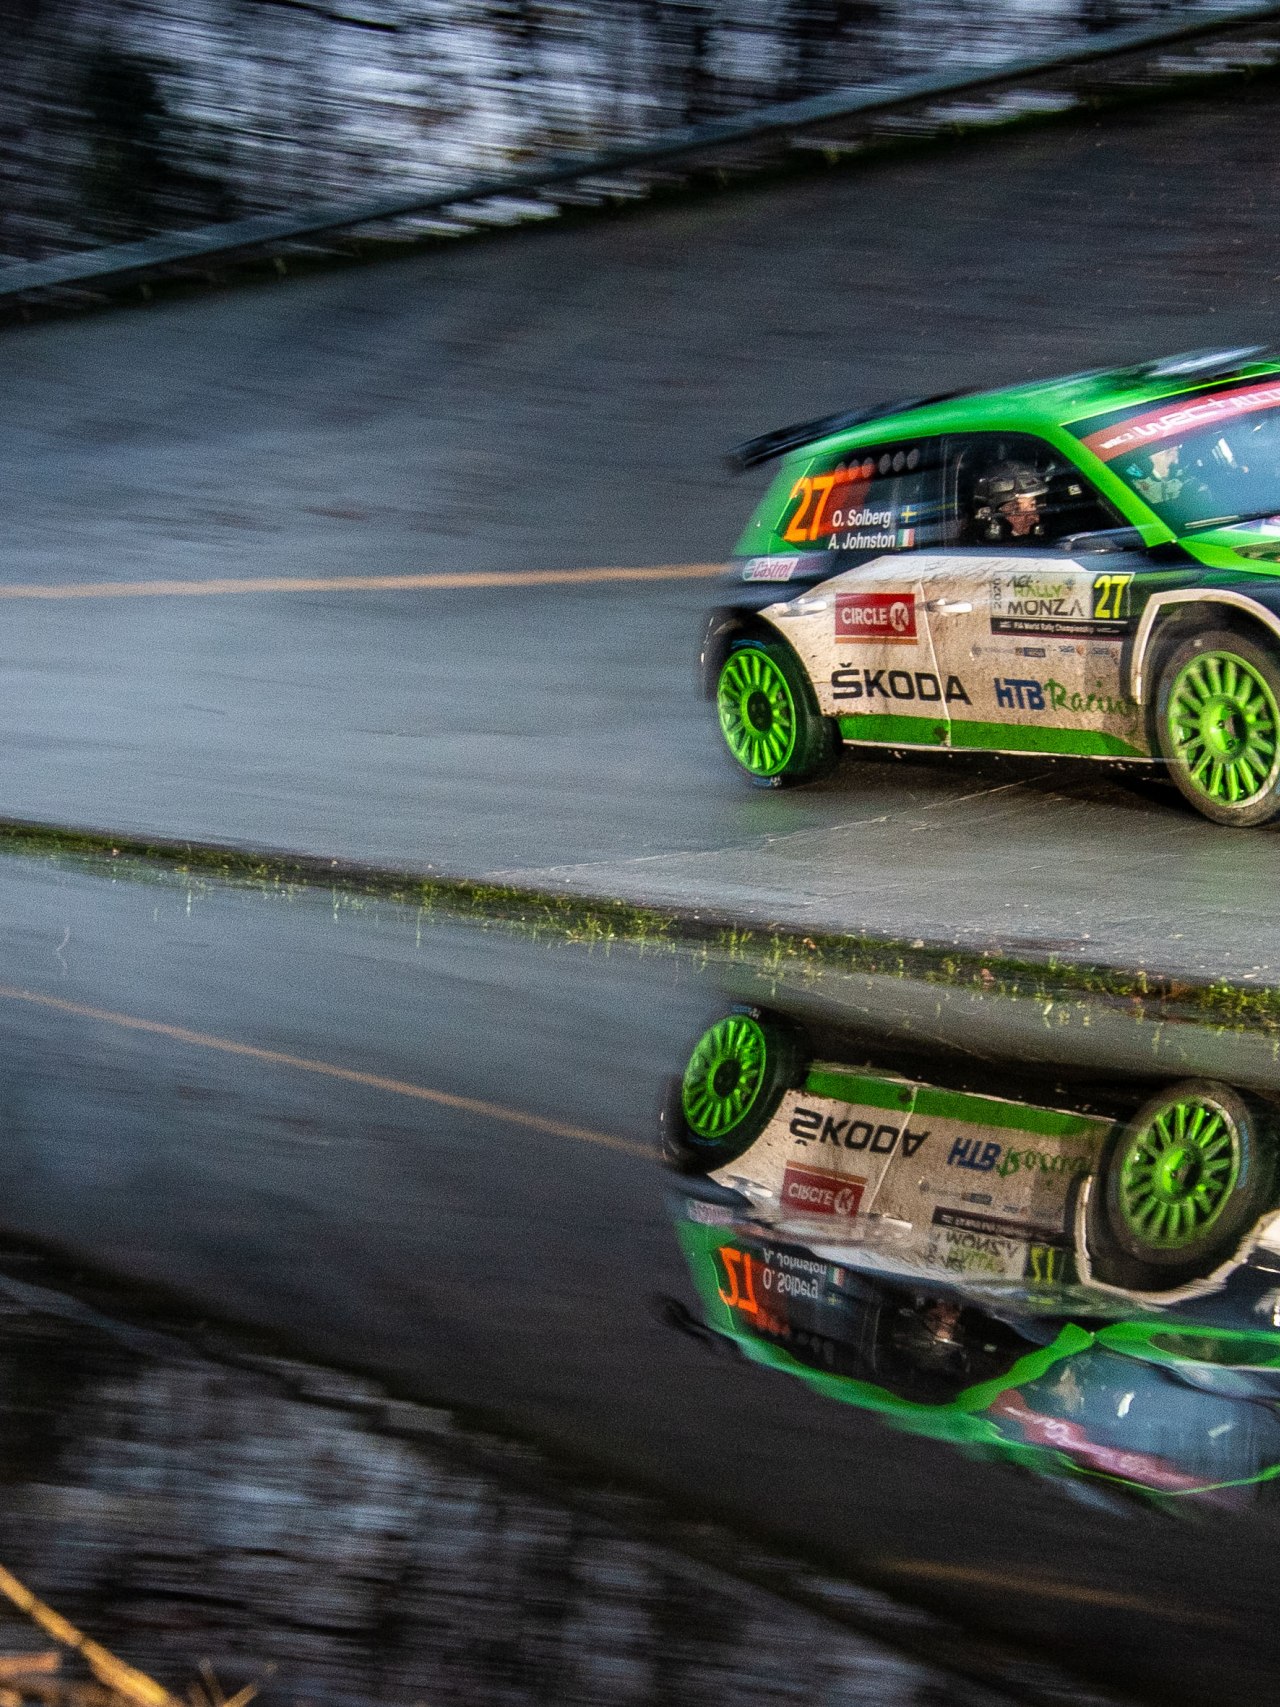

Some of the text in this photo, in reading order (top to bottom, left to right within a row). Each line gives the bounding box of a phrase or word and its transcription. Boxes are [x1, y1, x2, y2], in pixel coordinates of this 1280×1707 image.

[783, 476, 835, 542] 27
[832, 509, 892, 528] O. Solberg
[828, 533, 896, 550] A. Johnston
[753, 560, 794, 578] Castrol
[1013, 584, 1063, 598] RALLY
[1093, 574, 1131, 619] 27
[841, 602, 909, 632] CIRCLE K
[1007, 598, 1085, 617] MONZA
[831, 662, 974, 706] ŠKODA
[994, 677, 1046, 711] HTB
